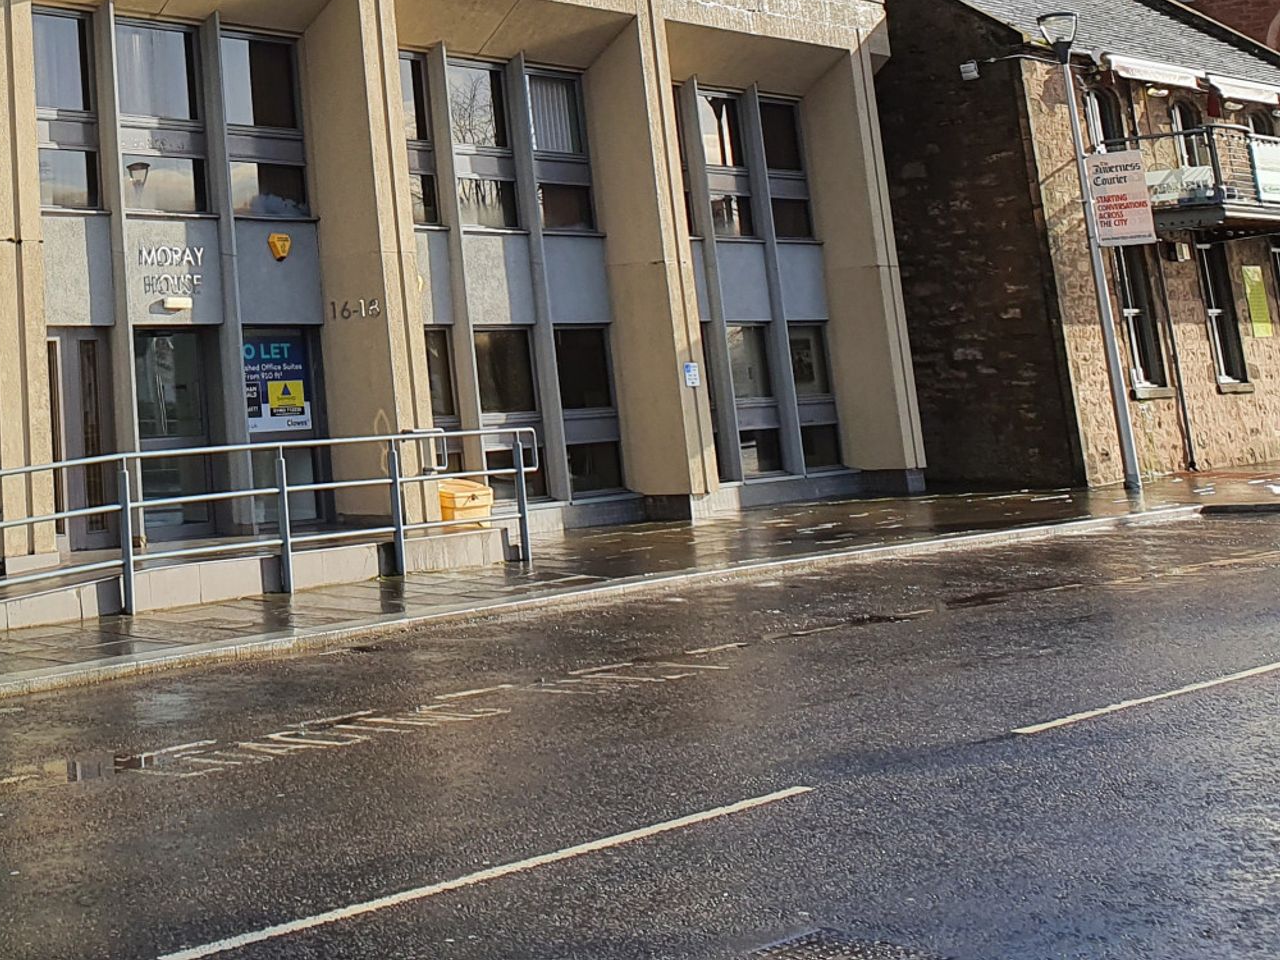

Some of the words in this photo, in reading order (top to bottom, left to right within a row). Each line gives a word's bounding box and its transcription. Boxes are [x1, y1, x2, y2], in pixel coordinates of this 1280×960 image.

[1092, 162, 1141, 174] Inverness
[1093, 174, 1128, 186] Courier
[1096, 194, 1128, 204] STARTING
[1098, 200, 1148, 212] CONVERSATIONS
[1098, 211, 1124, 219] ACROSS
[1100, 220, 1112, 228] THE
[1114, 218, 1128, 226] CITY
[141, 246, 204, 267] MORAY
[144, 274, 202, 296] HOUSE
[330, 298, 380, 320] 16-18
[260, 342, 290, 360] LET
